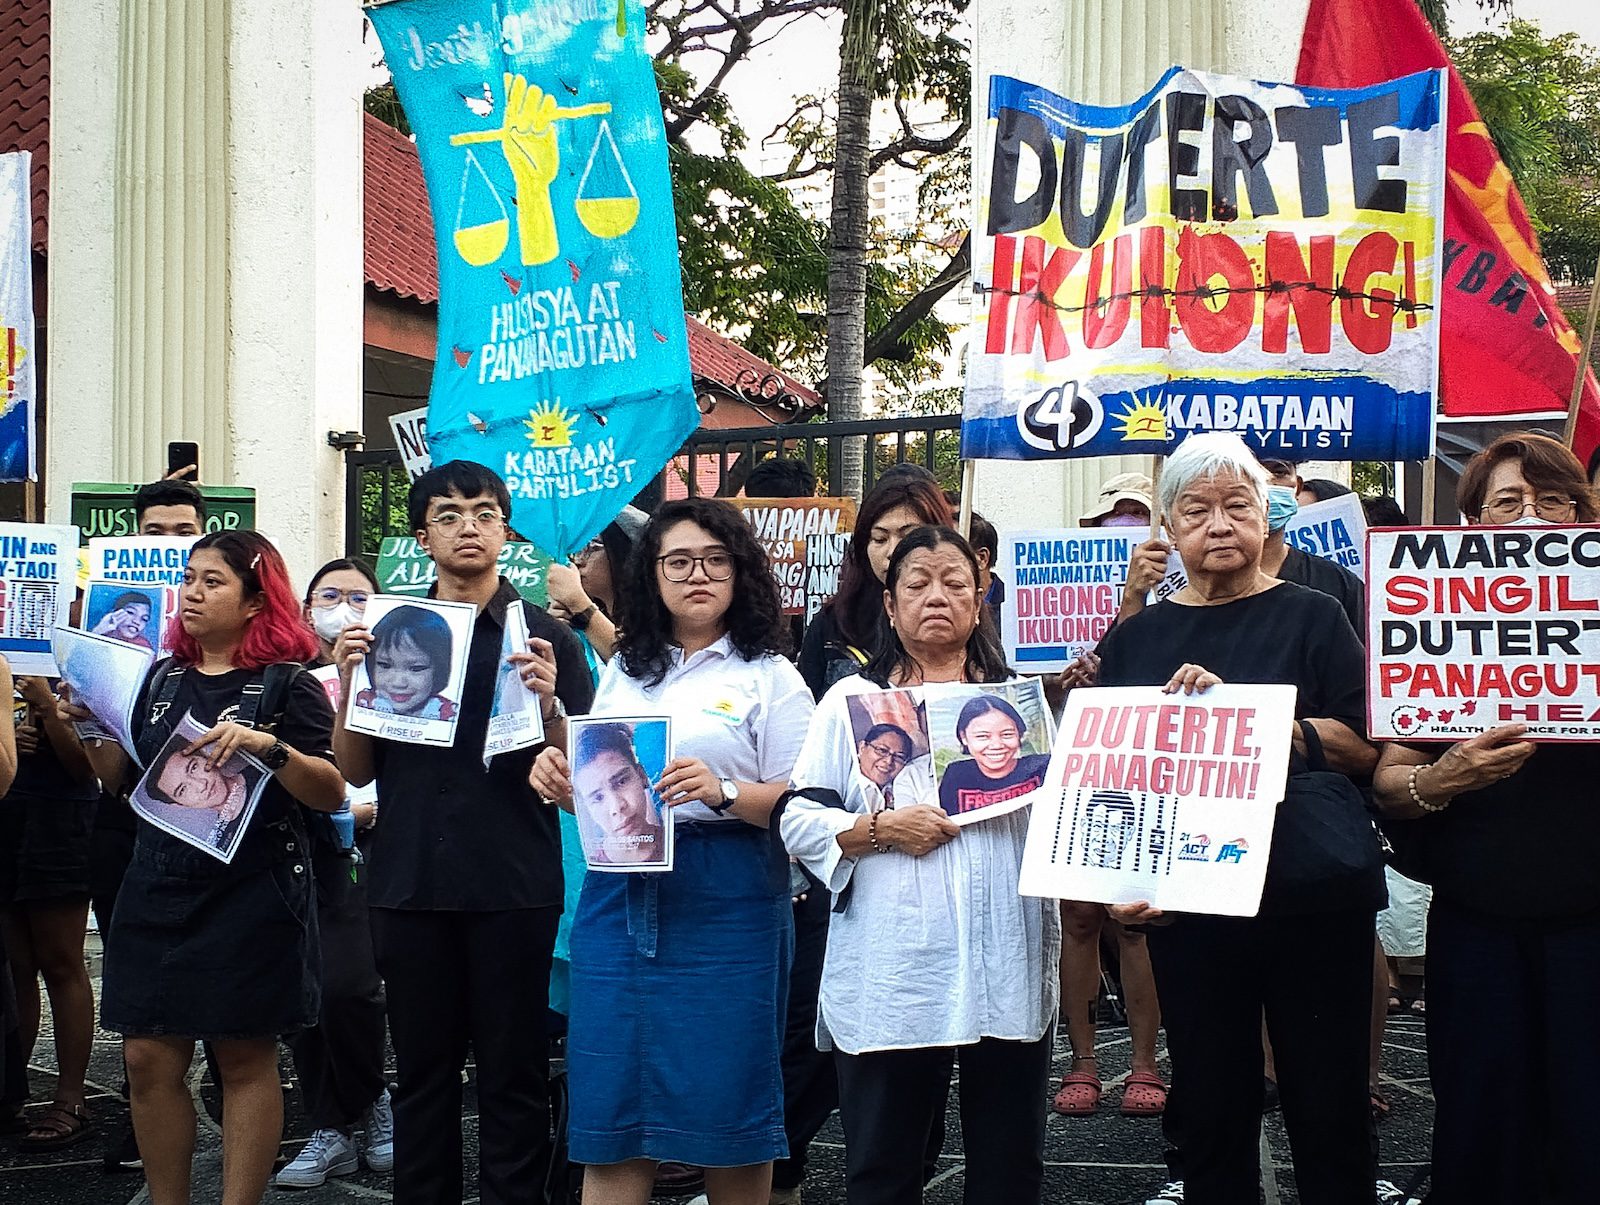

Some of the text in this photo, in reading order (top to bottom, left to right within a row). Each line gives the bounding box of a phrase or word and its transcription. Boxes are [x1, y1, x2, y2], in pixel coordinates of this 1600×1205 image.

[987, 91, 1407, 248] DUTERTE
[588, 281, 621, 322] AT
[1167, 394, 1353, 430] KABATAAN
[505, 437, 615, 476] KABATAAN
[506, 459, 637, 499] PARTYLIST
[30, 542, 57, 555] ANG
[1015, 538, 1128, 565] PANAGUTIN
[385, 561, 438, 584] ALL
[1017, 584, 1119, 618] DIGONG,
[1385, 575, 1599, 615] SINGIL
[387, 726, 424, 739] RISE UP
[1072, 705, 1261, 760] DUTERTE,
[1061, 753, 1260, 800] PANAGUTIN!
[1179, 843, 1208, 855] ACT
